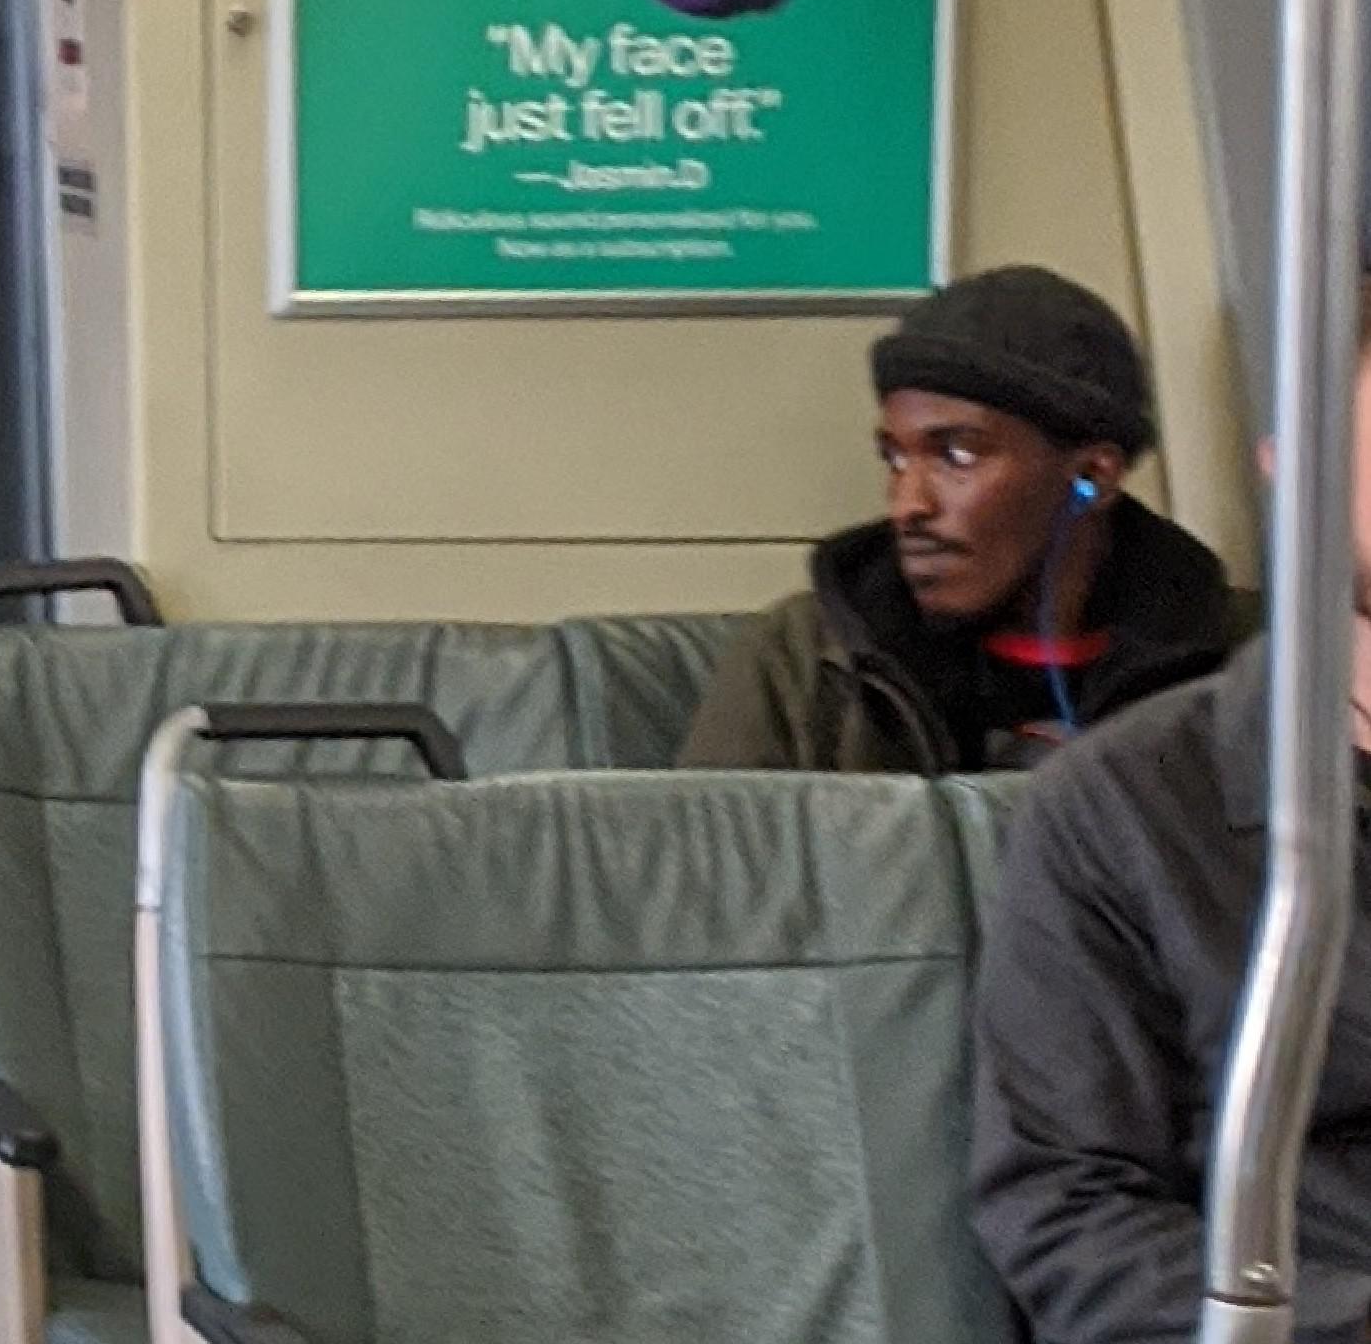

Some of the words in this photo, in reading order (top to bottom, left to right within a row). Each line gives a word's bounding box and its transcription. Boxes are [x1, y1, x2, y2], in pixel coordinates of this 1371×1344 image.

[607, 22, 735, 76] face
[460, 88, 573, 152] just
[580, 89, 665, 142] fell
